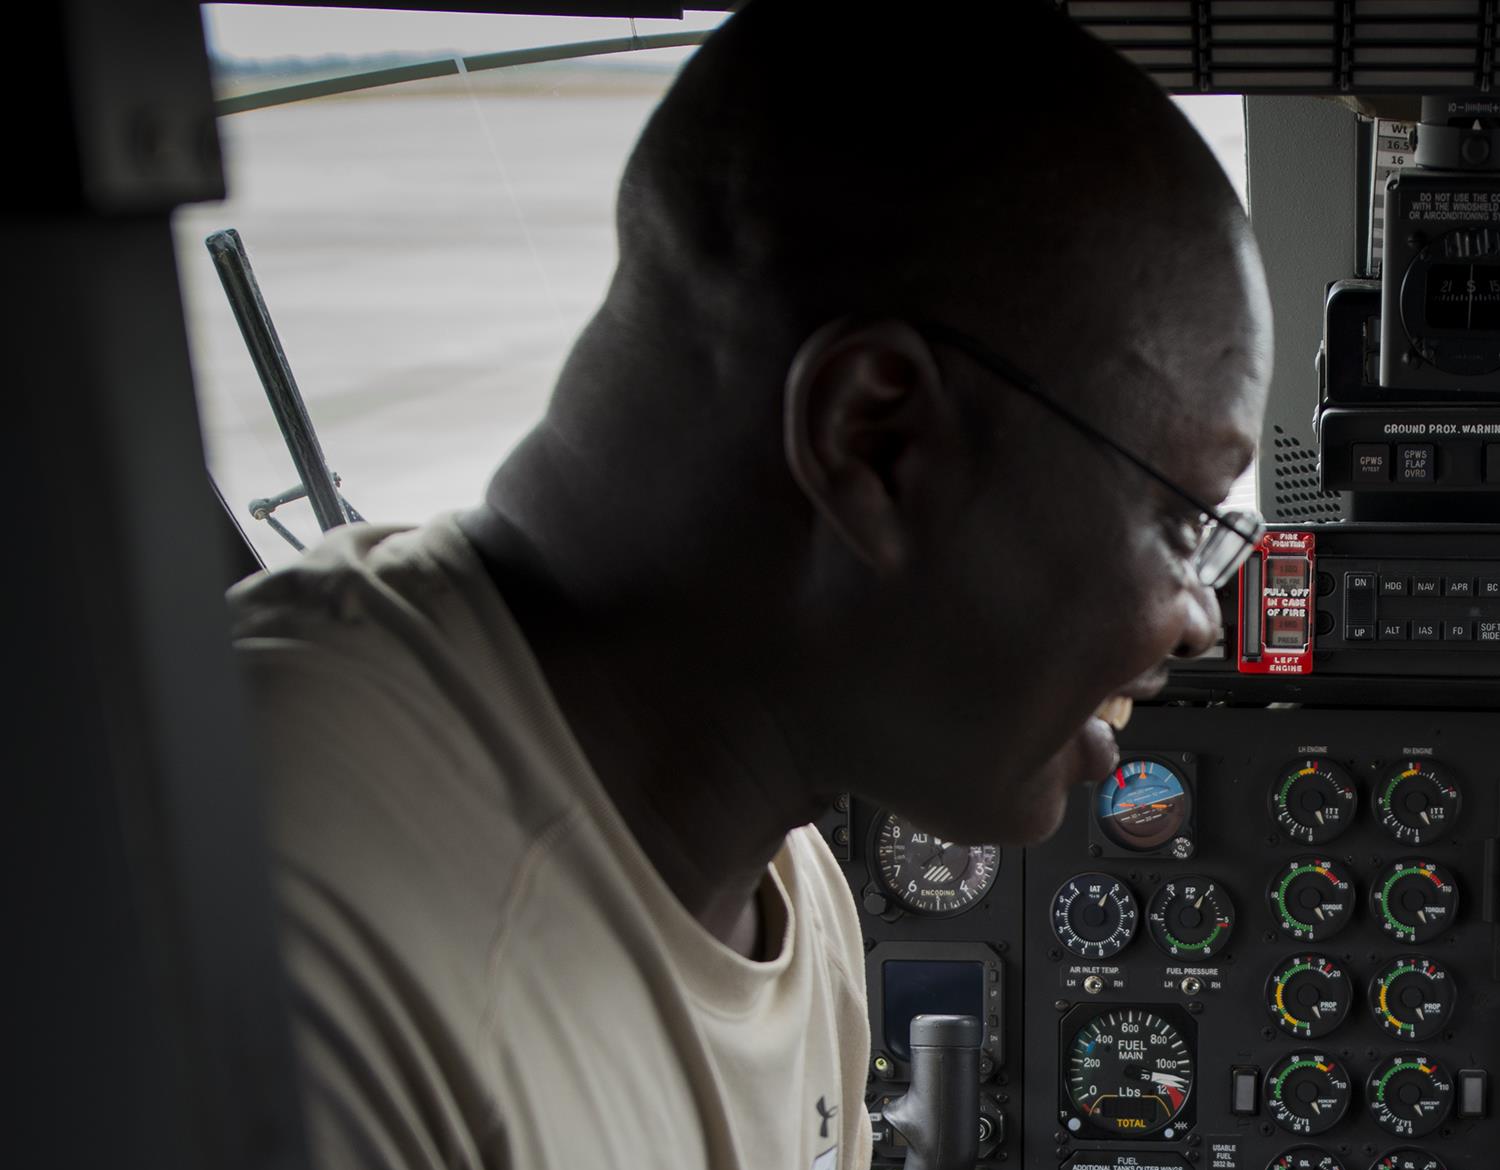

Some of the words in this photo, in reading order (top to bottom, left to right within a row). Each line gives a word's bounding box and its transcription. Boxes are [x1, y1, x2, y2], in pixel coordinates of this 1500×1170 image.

[1392, 124, 1407, 134] Wt
[1392, 155, 1404, 165] 16
[1420, 193, 1431, 202] DO
[1435, 193, 1450, 202] NOT
[1454, 193, 1469, 202] USE
[1473, 193, 1488, 202] THE
[1412, 202, 1432, 211] WITH
[1435, 202, 1449, 211] THE
[1453, 202, 1499, 212] WINDSHIELD
[1409, 211, 1421, 220] OR
[1384, 423, 1426, 435] GROUND
[1404, 449, 1428, 459] GPWS
[1359, 456, 1383, 466] GPWS
[1405, 459, 1426, 469] FLAP
[1405, 469, 1427, 479] OVRD
[1355, 578, 1368, 588] DN
[1384, 581, 1403, 591] HDG
[1417, 582, 1436, 592] NAV
[1451, 582, 1469, 592] APR
[1487, 582, 1499, 592] BC
[1263, 588, 1288, 597] PULL
[1290, 588, 1310, 597] OFF
[1267, 598, 1278, 607] IN
[1282, 598, 1306, 607] CASE
[1267, 608, 1280, 617] OF
[1283, 608, 1306, 617] FIRE
[1354, 627, 1366, 638] UP
[1385, 625, 1401, 636] ALT
[1418, 626, 1434, 636] IAS
[1452, 626, 1464, 636] FD
[1482, 631, 1500, 641] RIDE
[1274, 656, 1299, 664] LEFT
[1269, 664, 1303, 673] ENGINE
[1307, 745, 1328, 753] ENGINE
[1412, 747, 1433, 755] ENGINE
[893, 826, 901, 838] 8
[911, 833, 928, 843] ALT
[893, 864, 901, 878] 7
[975, 862, 984, 876] 3
[908, 880, 918, 893] 6
[960, 879, 969, 892] 4
[1090, 885, 1102, 893] IAT
[1185, 886, 1197, 894] FP
[1322, 903, 1343, 911] TORQUE
[1424, 906, 1446, 914] TORQUE
[1069, 966, 1081, 974] AIR
[1082, 966, 1101, 974] INLET
[1166, 967, 1183, 975] FUEL
[1184, 967, 1219, 976] PRESSURE
[1066, 979, 1076, 987] LH
[1114, 979, 1124, 988] RH
[1163, 980, 1173, 988] LH
[1211, 981, 1221, 989] RH
[1121, 1023, 1139, 1033] 600
[1096, 1034, 1113, 1044] 400
[1150, 1035, 1168, 1045] 800
[1118, 1040, 1147, 1051] FUEL
[1119, 1051, 1143, 1061] MAIN
[1083, 1058, 1101, 1068] 200
[1155, 1058, 1177, 1069] 1000
[1089, 1085, 1098, 1096] 0
[1119, 1086, 1142, 1098] Lbs
[1116, 1118, 1147, 1129] TOTAL
[1212, 1144, 1236, 1153] USABLE
[1117, 1156, 1139, 1166] FUEL
[1216, 1152, 1232, 1160] FUEL
[1299, 1160, 1311, 1168] OIL
[1404, 1162, 1416, 1170] OIL
